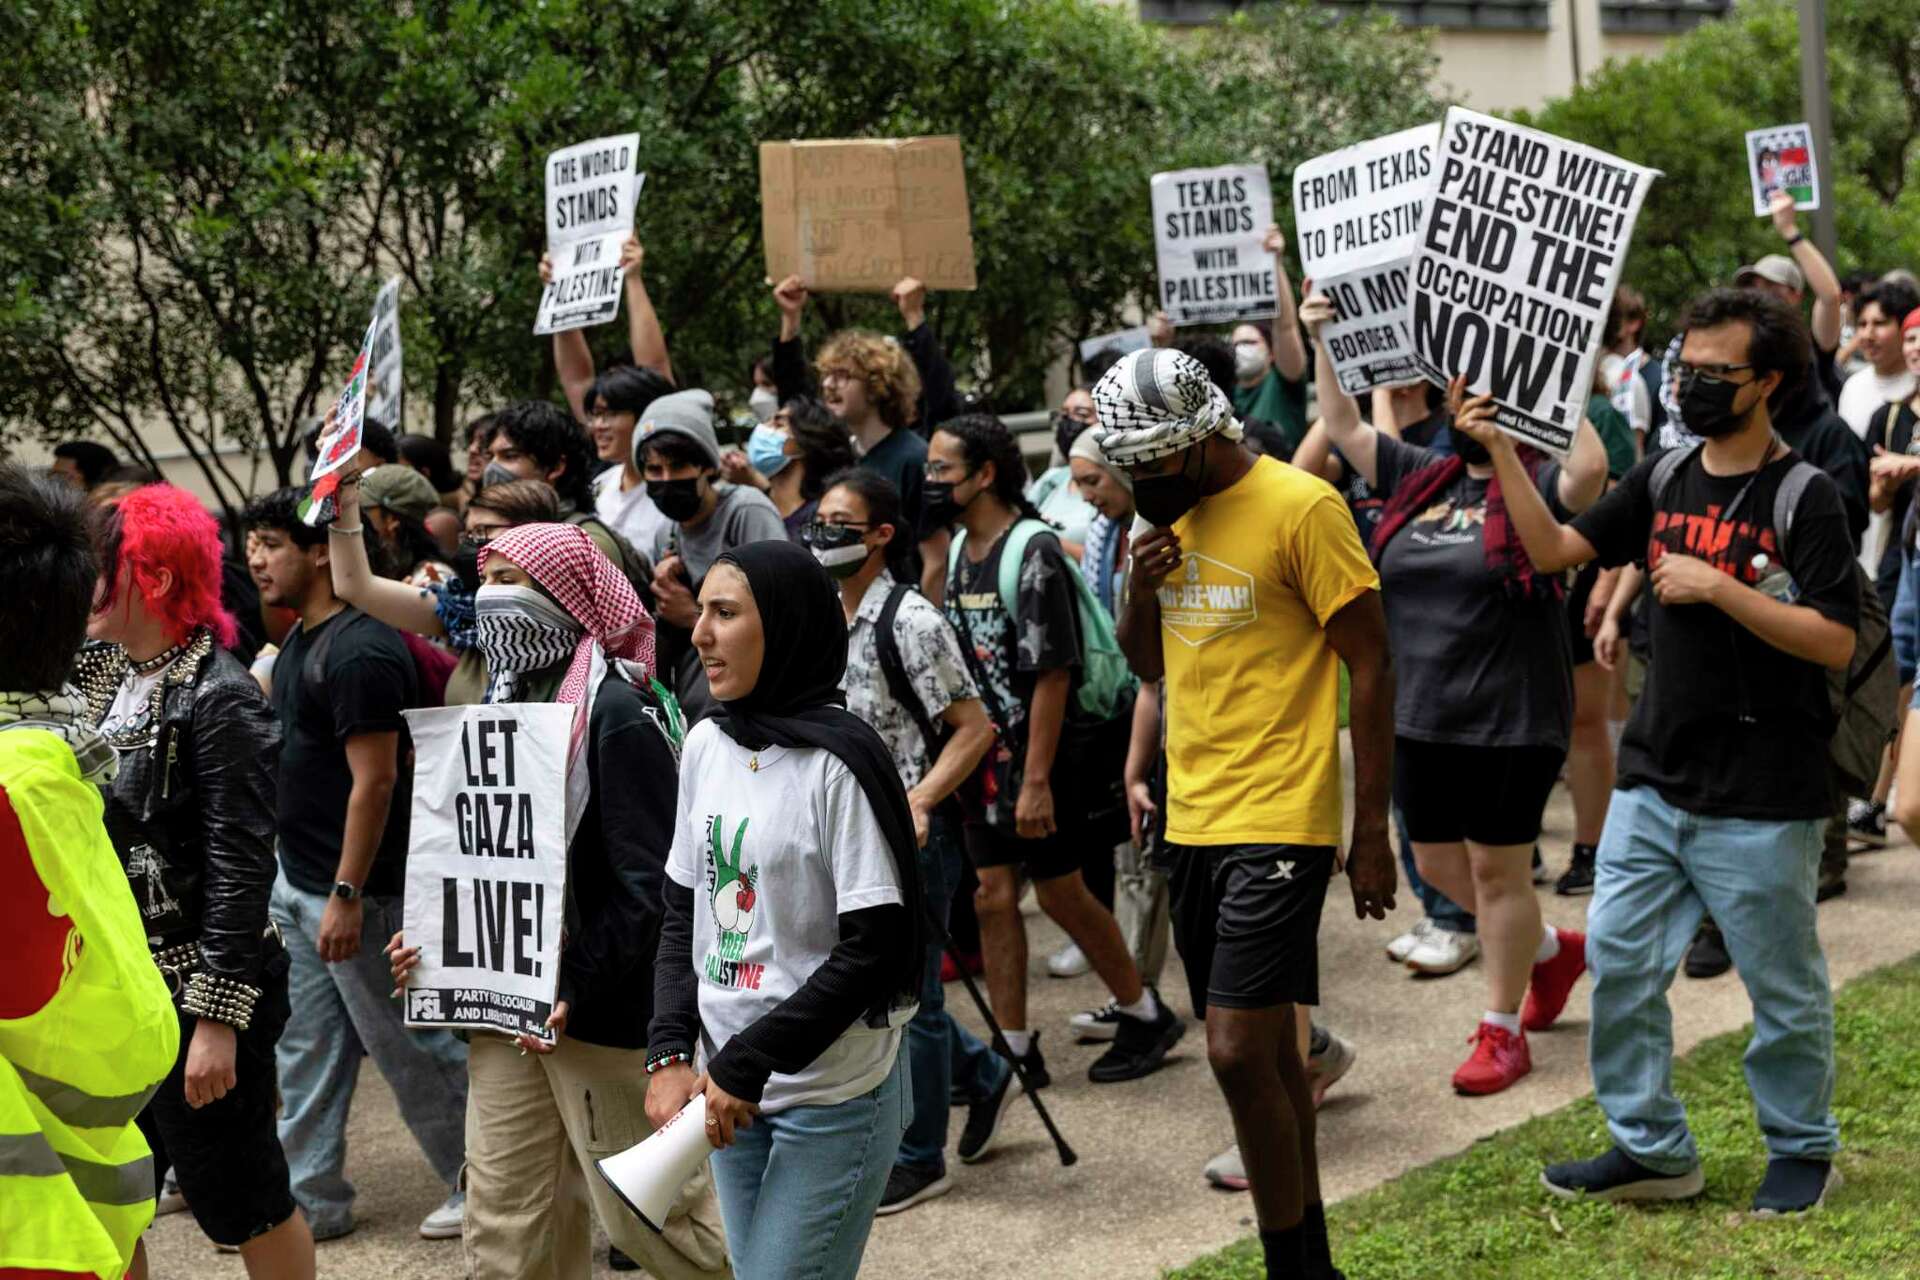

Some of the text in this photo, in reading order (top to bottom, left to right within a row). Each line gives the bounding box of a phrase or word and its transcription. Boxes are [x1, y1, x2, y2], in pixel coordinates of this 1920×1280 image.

[554, 146, 629, 186] THE WORLD
[1300, 145, 1431, 212] FROM TEXAS
[1450, 121, 1639, 208] STAND WITH
[557, 185, 618, 229] STANDS
[1176, 177, 1246, 208] TEXAS
[1440, 157, 1624, 251] PALESTINE!
[1166, 206, 1253, 239] STANDS
[1303, 200, 1423, 261] TO PALESTIN
[574, 239, 603, 266] WITH
[1193, 247, 1238, 270] WITH
[1425, 197, 1613, 310] END THE
[545, 266, 620, 309] PALESTINE
[1165, 271, 1273, 304] PALESTINE
[1322, 282, 1362, 323] NO
[1417, 255, 1593, 353] OCCUPATION
[1329, 325, 1400, 361] BORDER
[1414, 290, 1580, 425] NOW!
[1517, 414, 1569, 447] Liberation
[462, 719, 518, 786] LET
[456, 792, 535, 859] GAZA
[442, 878, 544, 978] LIVE!
[704, 953, 765, 990] PALESTINE
[411, 997, 446, 1020] PSL
[453, 1007, 481, 1019] AND
[454, 990, 490, 1002] PARTY
[500, 995, 536, 1013] SOCIALISM
